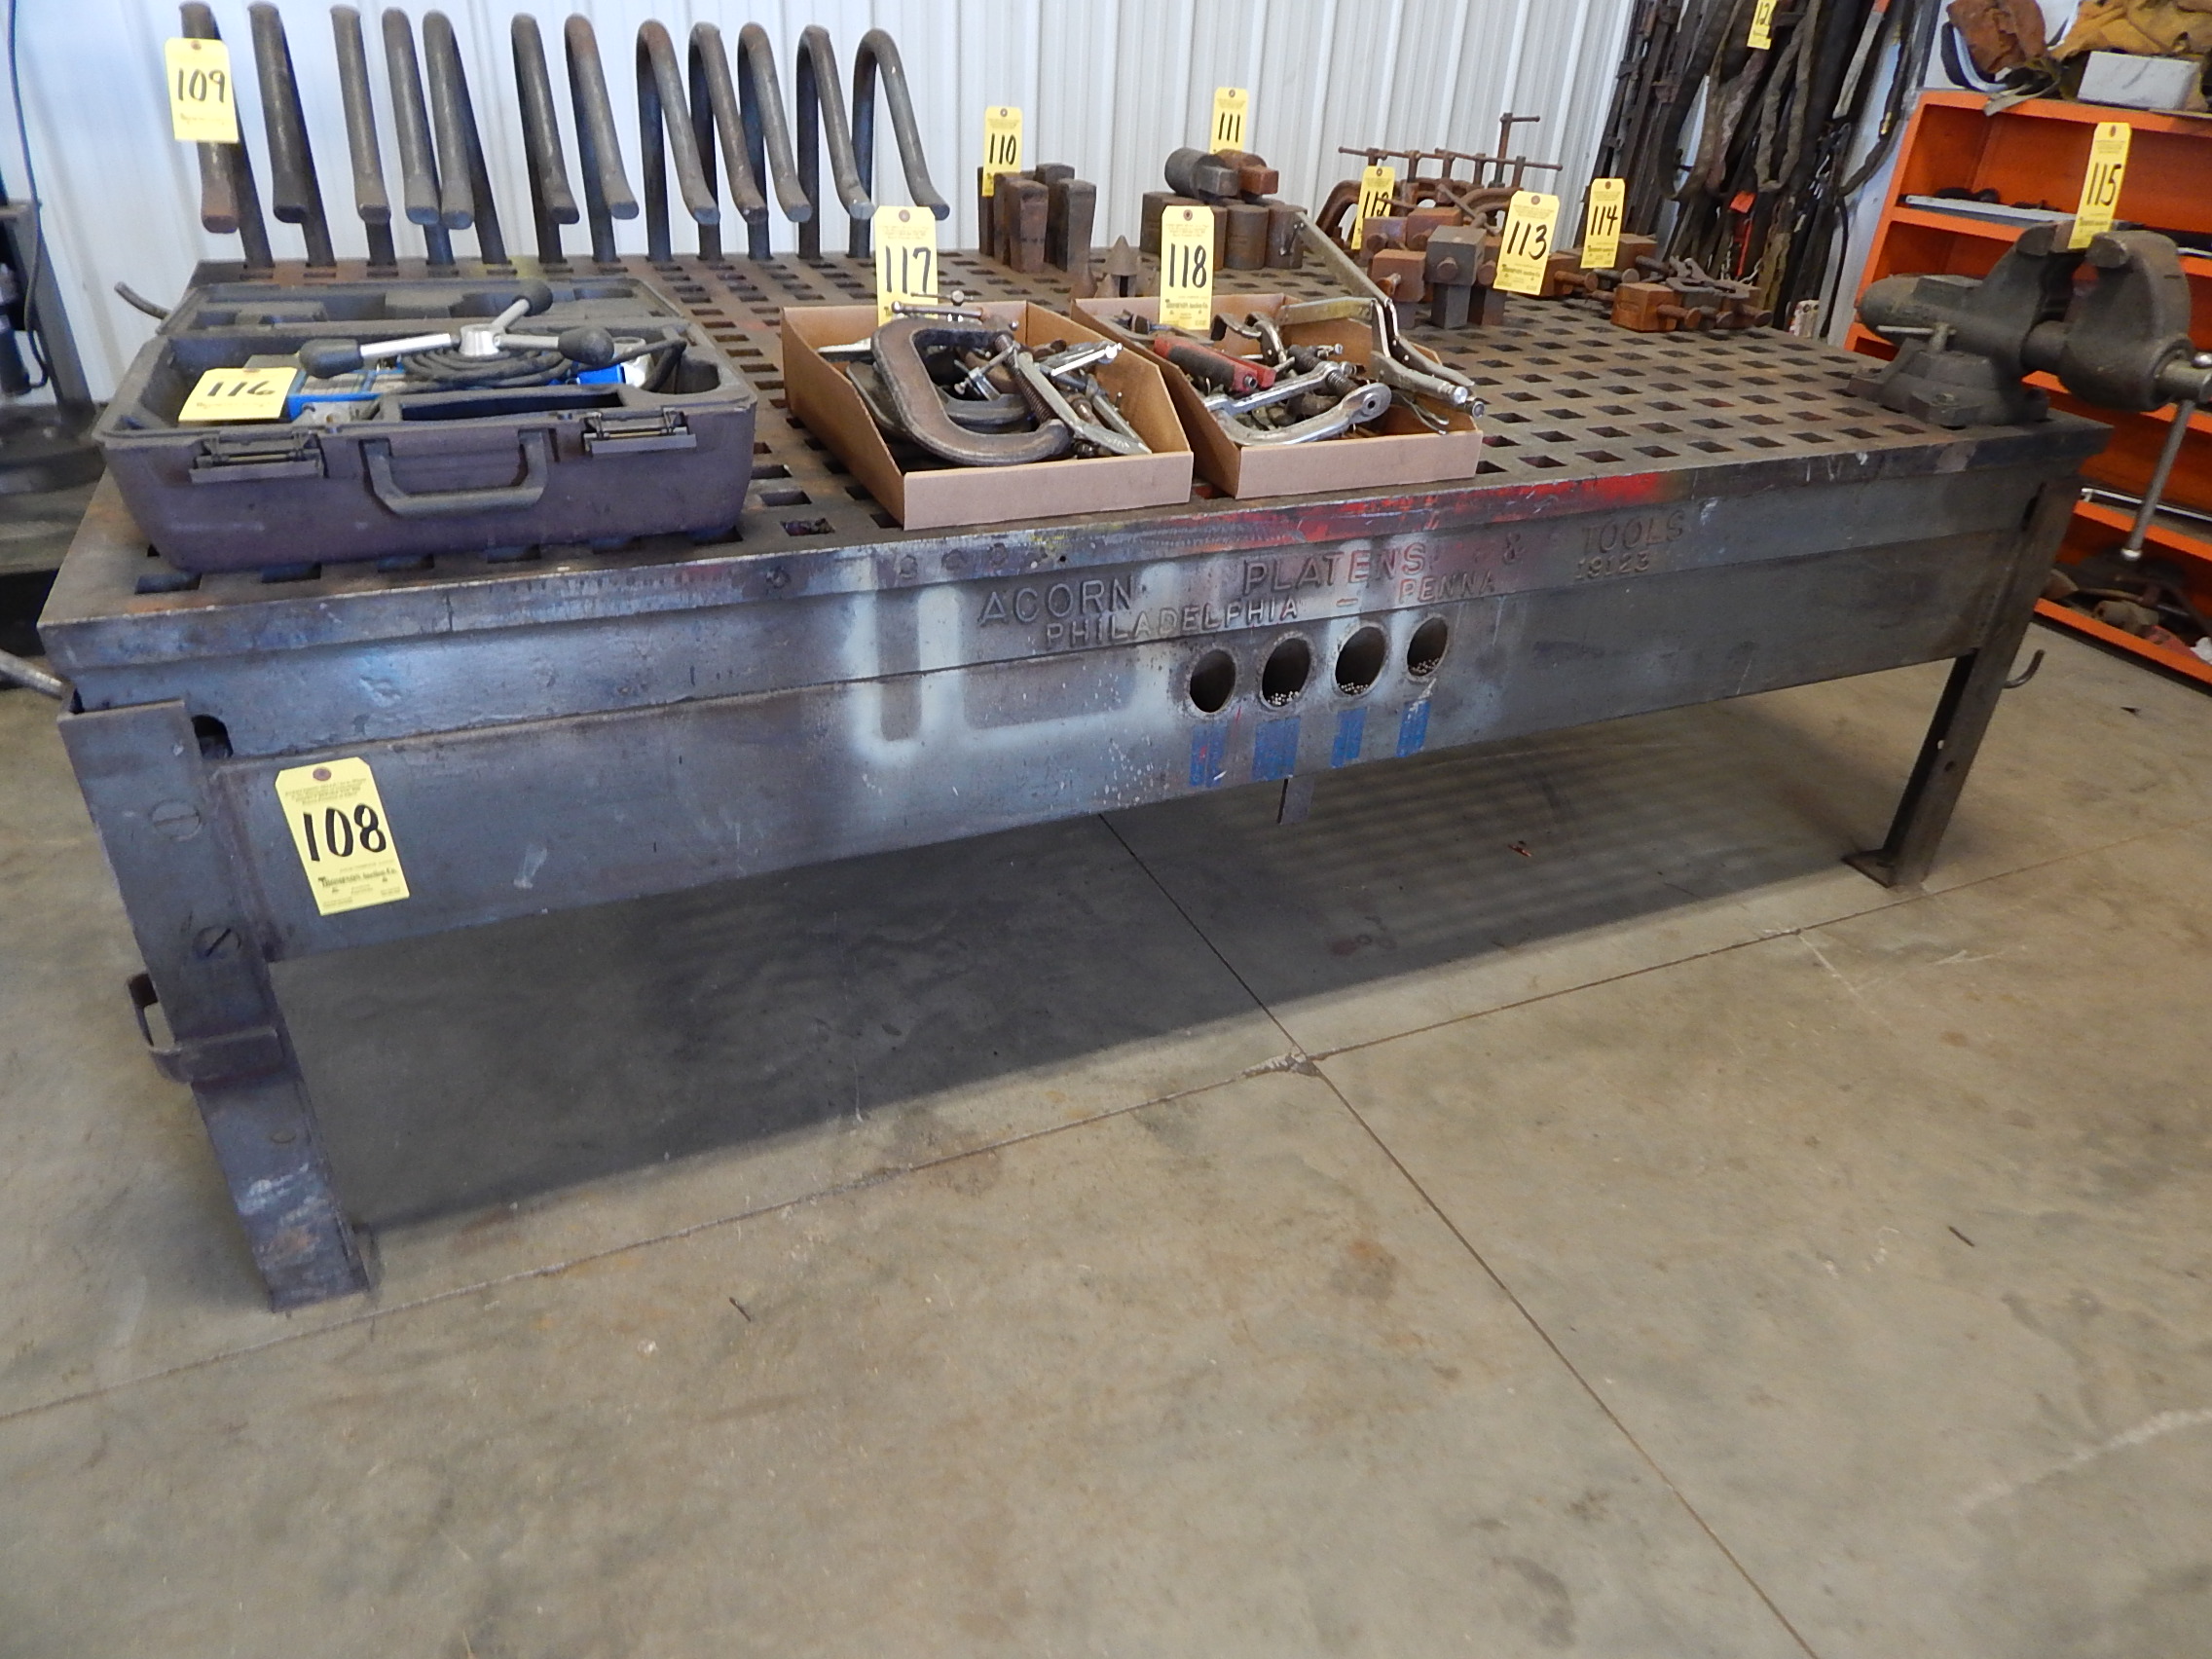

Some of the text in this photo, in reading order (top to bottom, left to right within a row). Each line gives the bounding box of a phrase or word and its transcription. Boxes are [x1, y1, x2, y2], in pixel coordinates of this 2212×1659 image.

[178, 67, 225, 103] 109
[1218, 112, 1240, 143] 111
[989, 133, 1016, 165] 110
[2086, 162, 2121, 205] 115
[1507, 220, 1547, 260] 113
[1590, 205, 1617, 236] 114
[886, 245, 931, 294] 117
[1169, 243, 1206, 288] 118
[207, 380, 276, 397] 116
[977, 574, 1133, 628] ACORN
[1241, 542, 1427, 596] PLATENS
[1579, 509, 1685, 554] TOOLS
[1045, 596, 1299, 649] PHILADELPHIA
[1398, 570, 1496, 605] PENNA
[303, 803, 387, 862] 108
